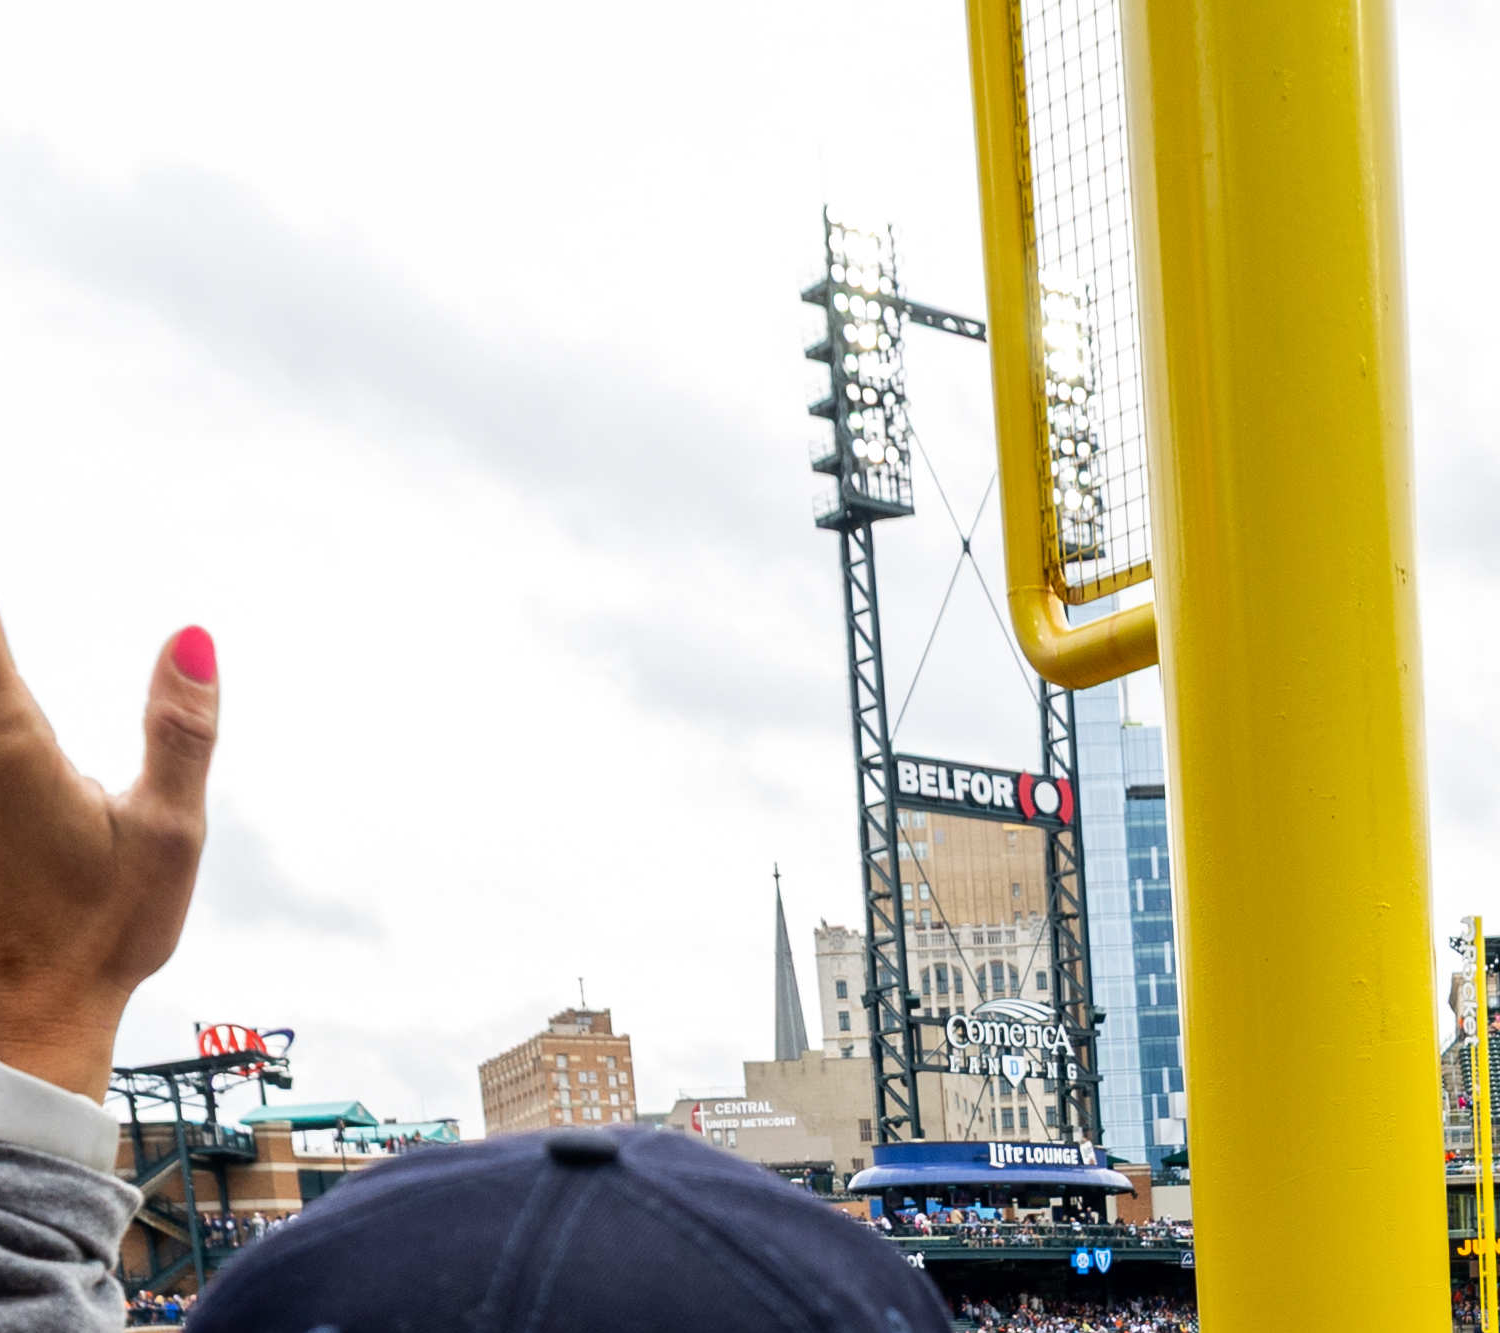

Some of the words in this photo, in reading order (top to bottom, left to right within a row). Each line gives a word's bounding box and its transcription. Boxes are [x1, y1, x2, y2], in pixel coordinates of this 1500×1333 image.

[897, 759, 1014, 809] BELFOR
[988, 1142, 1024, 1169] Lite
[1026, 1147, 1079, 1165] LOUNGE
